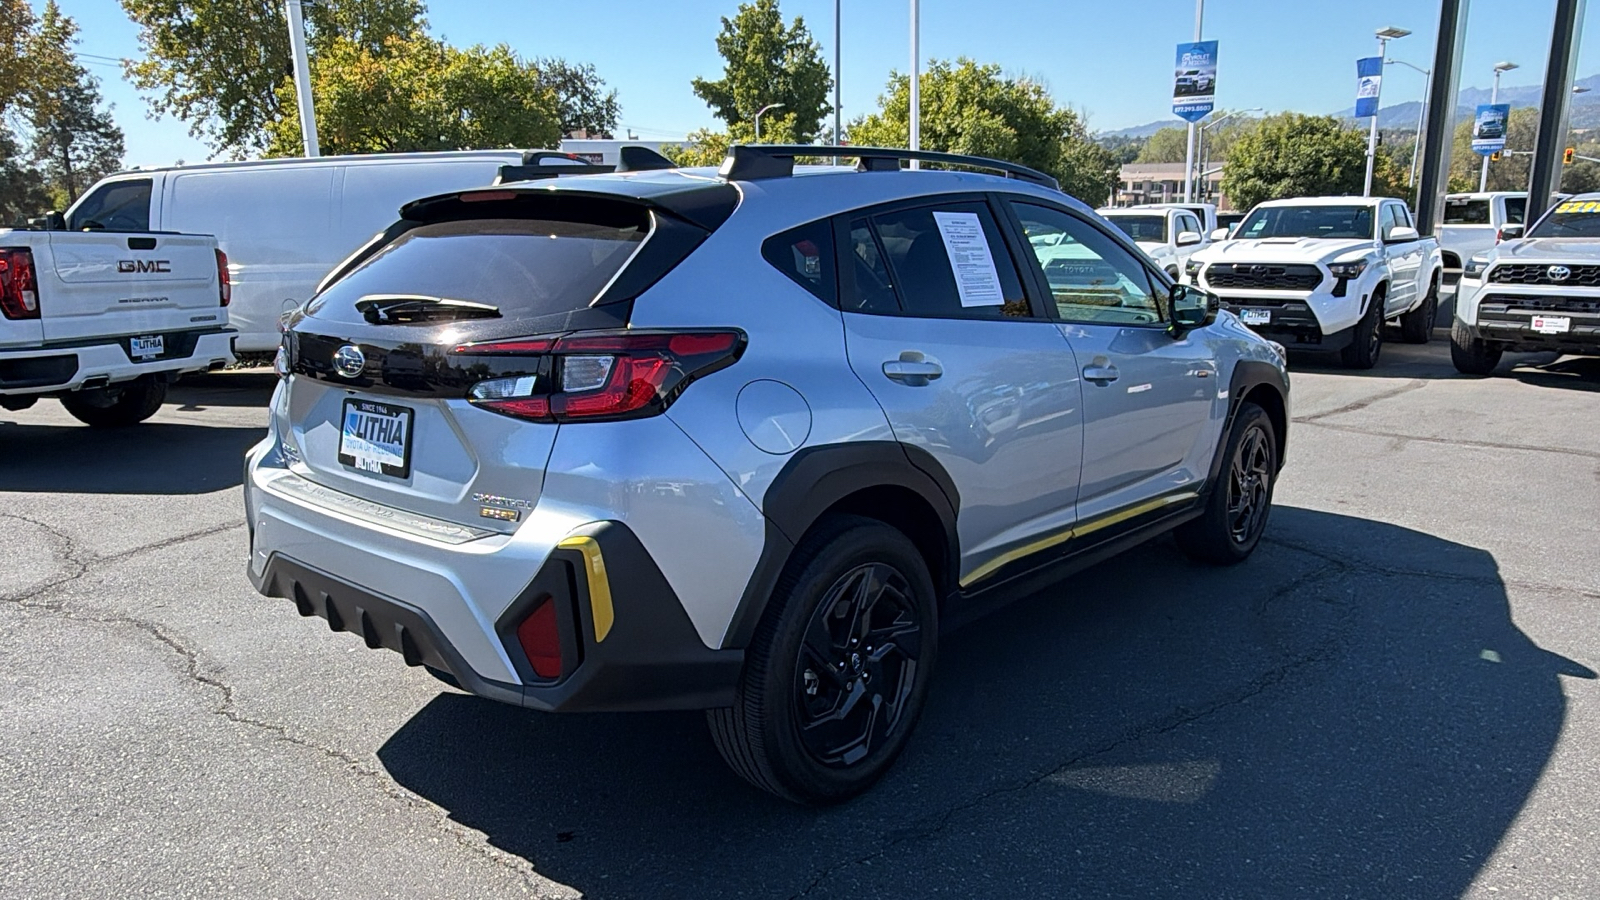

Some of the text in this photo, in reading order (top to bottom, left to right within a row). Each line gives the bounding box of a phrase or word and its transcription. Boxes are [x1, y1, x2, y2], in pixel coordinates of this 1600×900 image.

[117, 259, 171, 273] GMC
[139, 338, 163, 349] LITHIA
[361, 403, 388, 414] SINCE 1946
[355, 414, 404, 446] LITHIA
[361, 457, 383, 474] LITHIA
